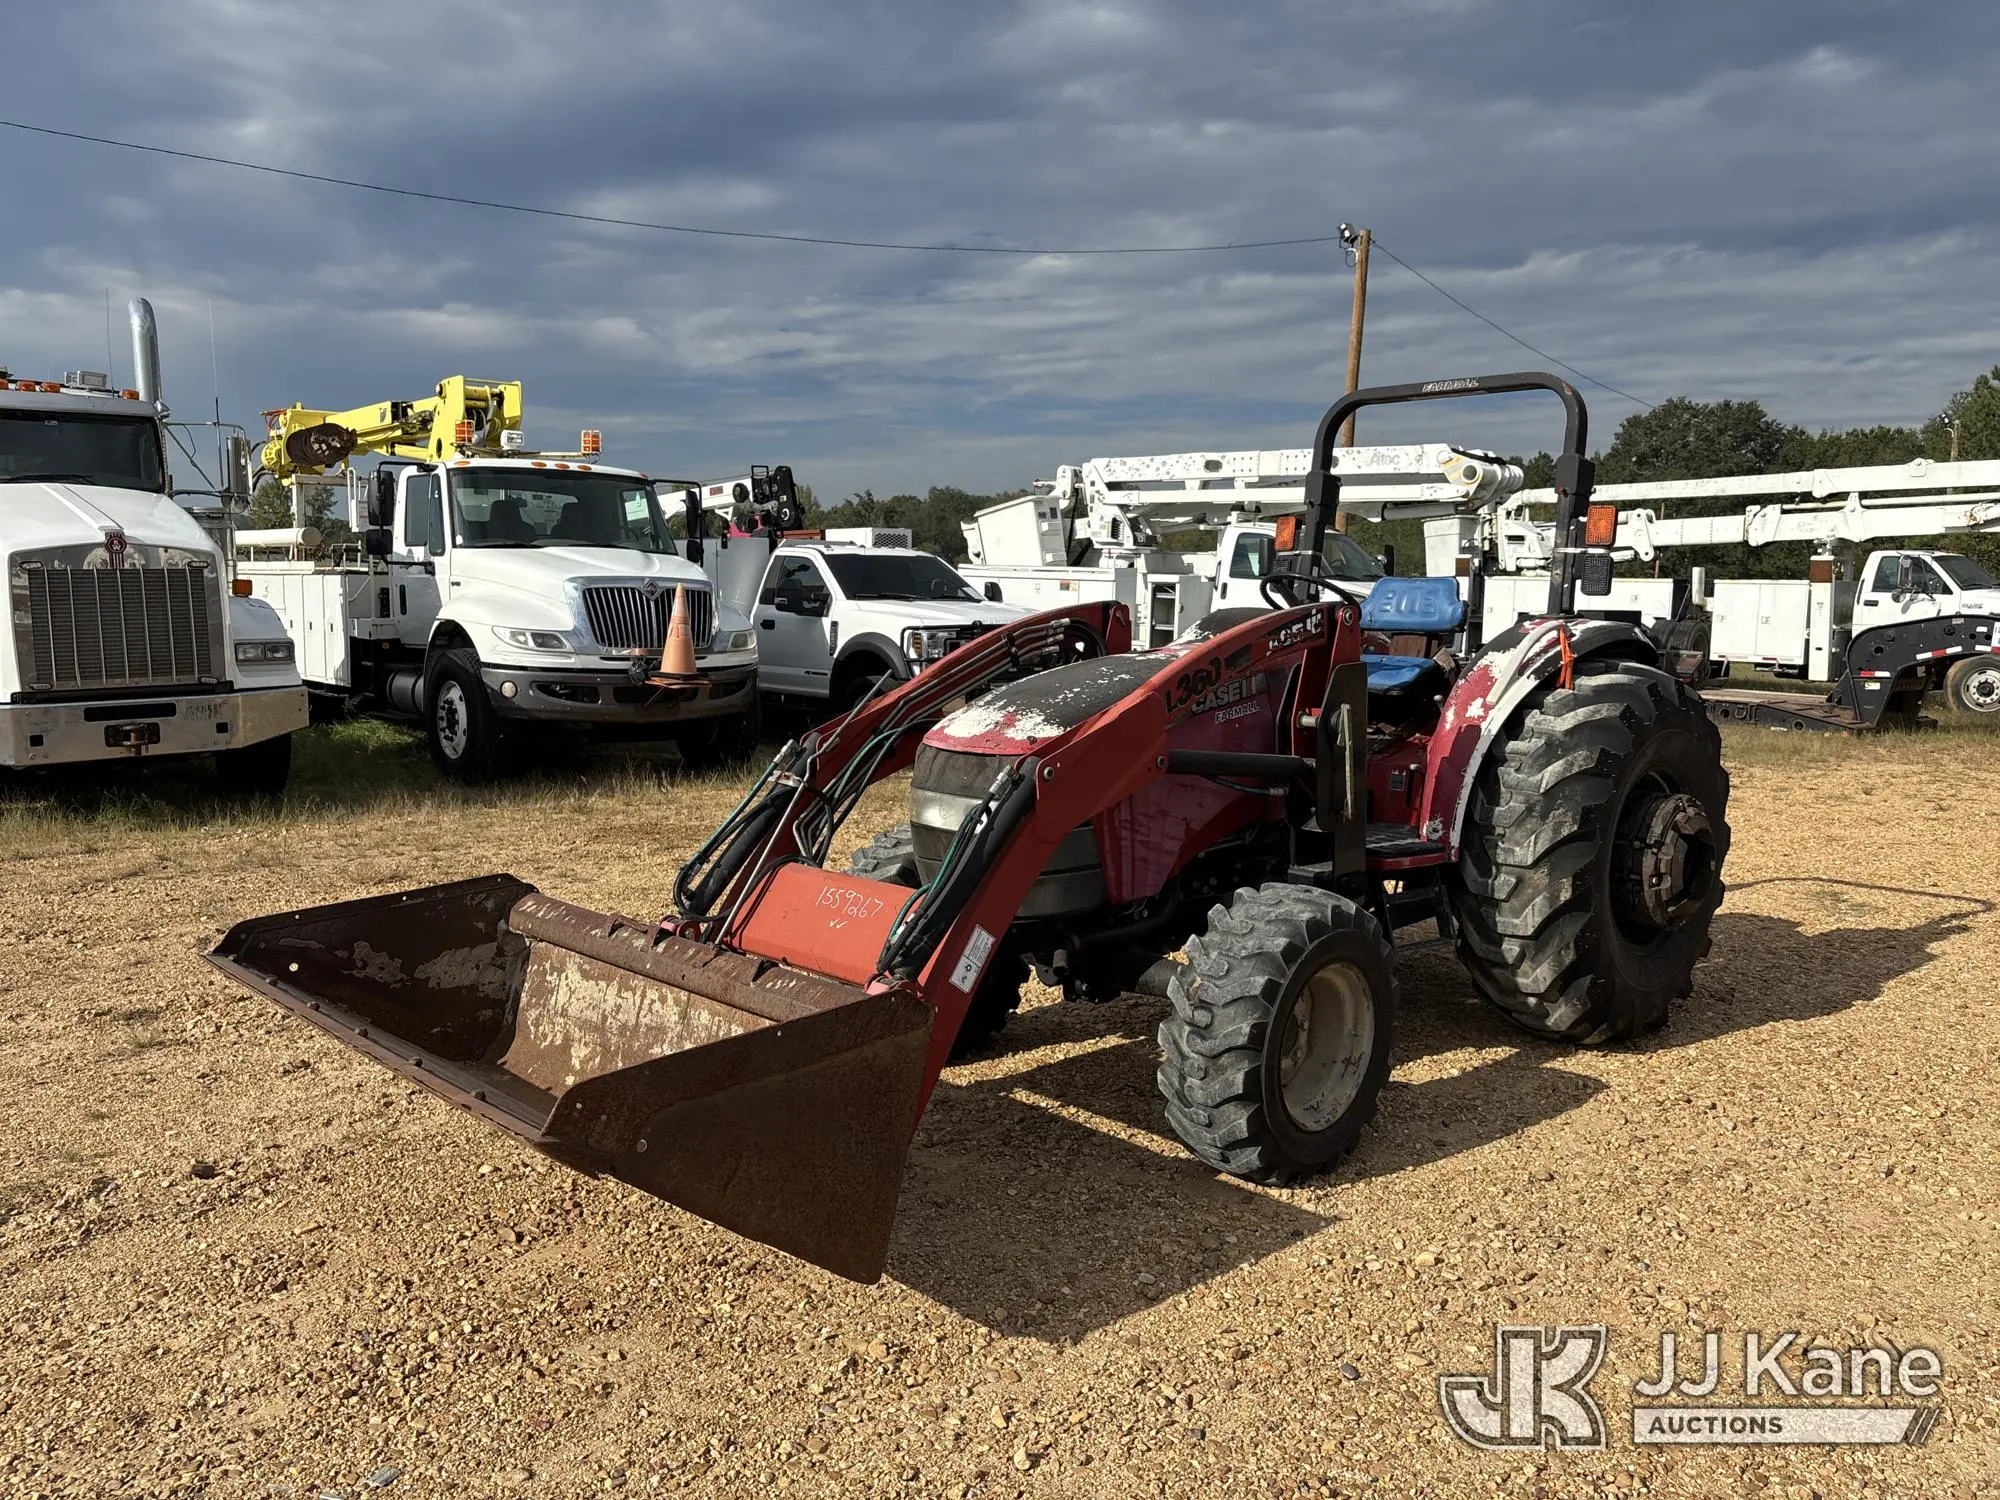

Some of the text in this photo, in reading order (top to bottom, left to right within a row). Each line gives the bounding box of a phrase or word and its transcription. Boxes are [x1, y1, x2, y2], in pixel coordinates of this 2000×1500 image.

[1421, 378, 1480, 393] FARMALL
[1215, 700, 1260, 725] FARMALL
[815, 886, 885, 919] 1559267
